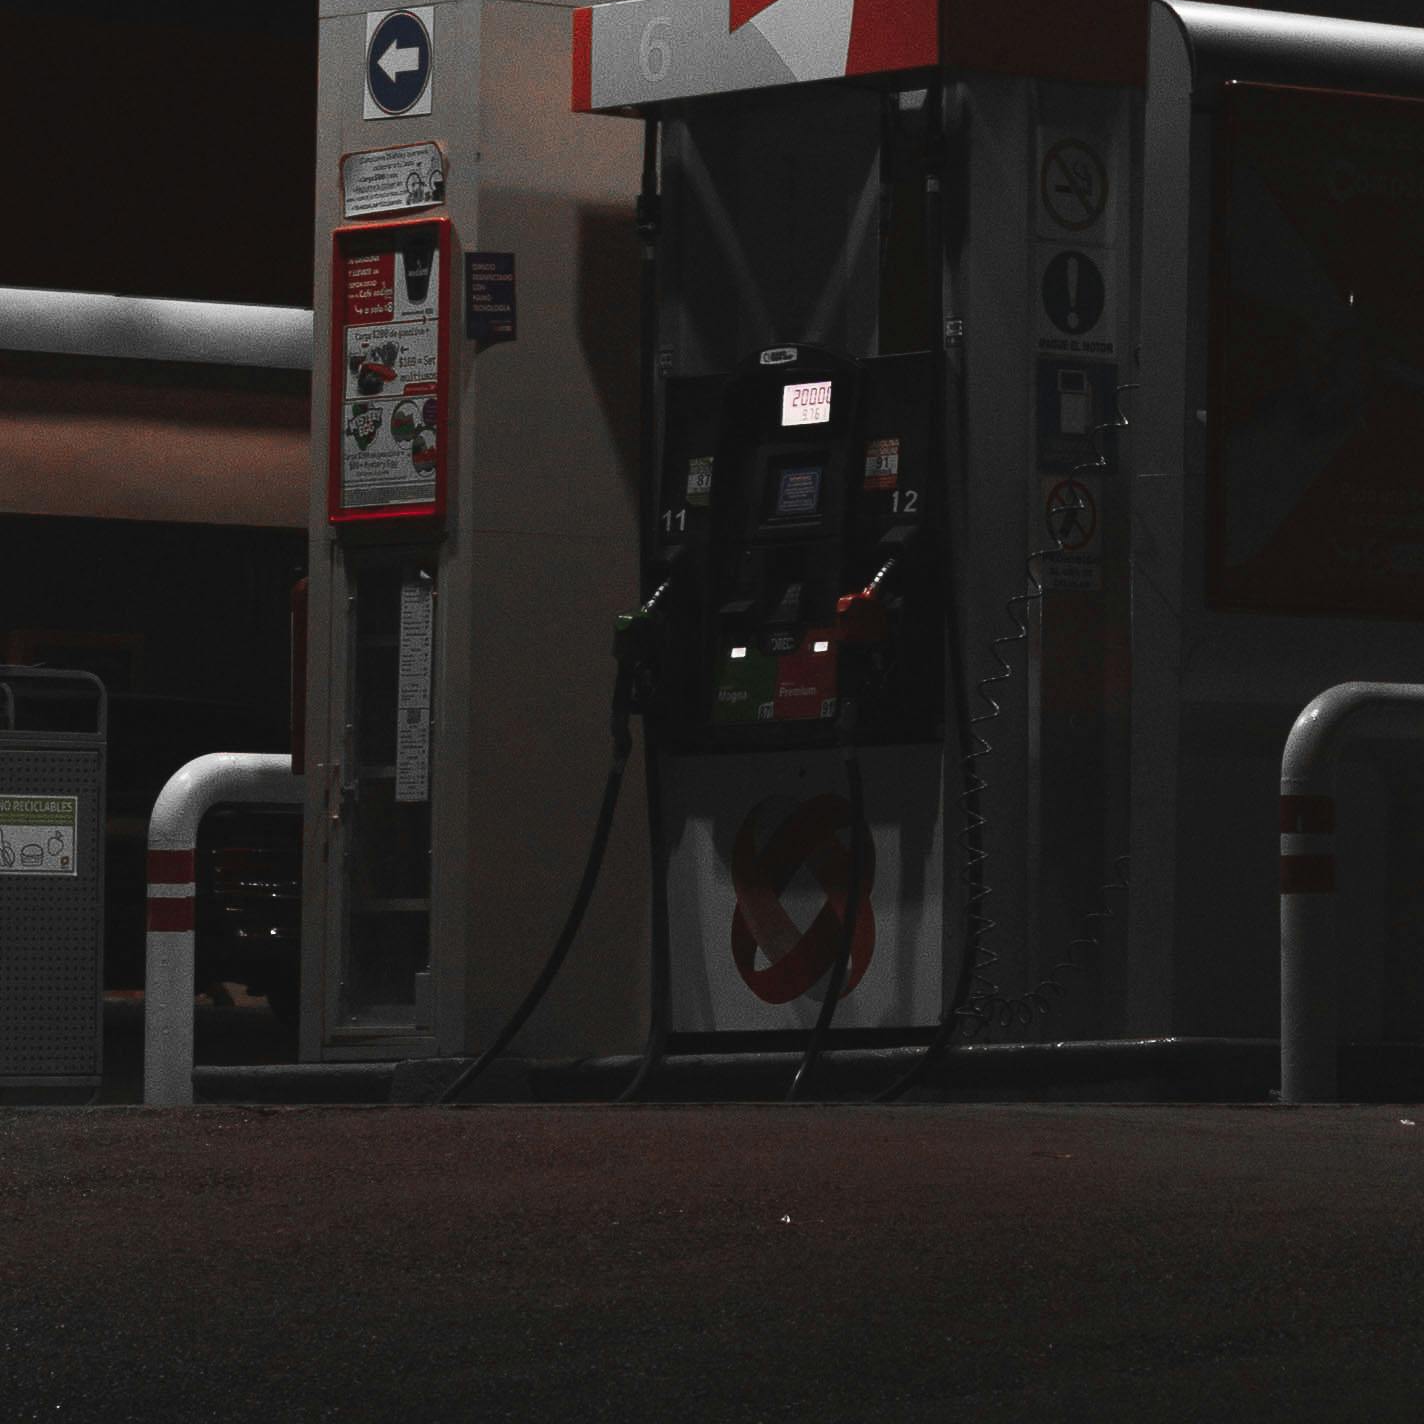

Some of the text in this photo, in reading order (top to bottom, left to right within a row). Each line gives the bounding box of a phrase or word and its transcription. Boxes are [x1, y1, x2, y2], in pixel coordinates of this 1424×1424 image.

[639, 15, 673, 83] 6
[890, 489, 918, 513] 12
[661, 508, 687, 532] 11
[779, 686, 817, 698] Premium
[13, 800, 73, 813] RECICLABLES
